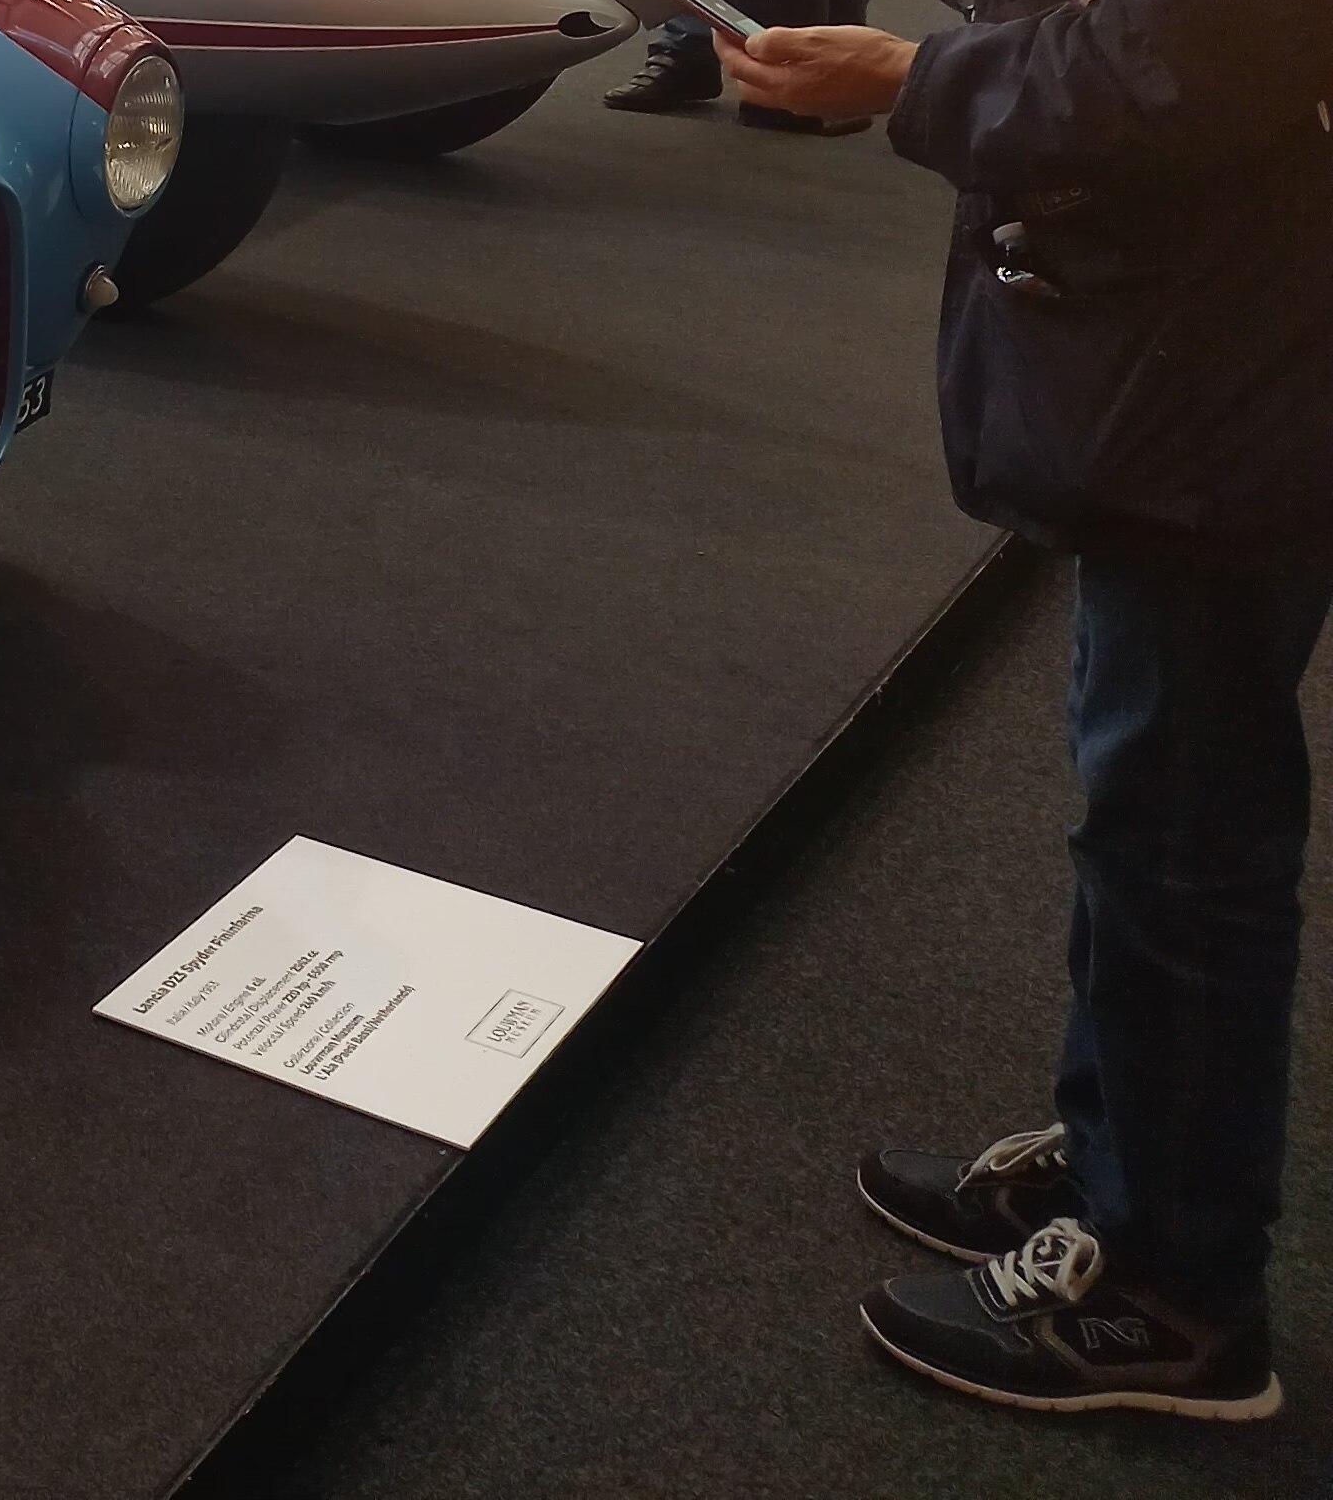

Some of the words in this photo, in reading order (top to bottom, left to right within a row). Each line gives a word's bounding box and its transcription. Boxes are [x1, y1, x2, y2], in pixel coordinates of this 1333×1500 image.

[131, 986, 171, 1014] Lancia
[161, 971, 188, 988] D23
[179, 944, 220, 974] Spyder
[209, 905, 265, 947] Pininfarina
[485, 1000, 534, 1042] LOUWMAN
